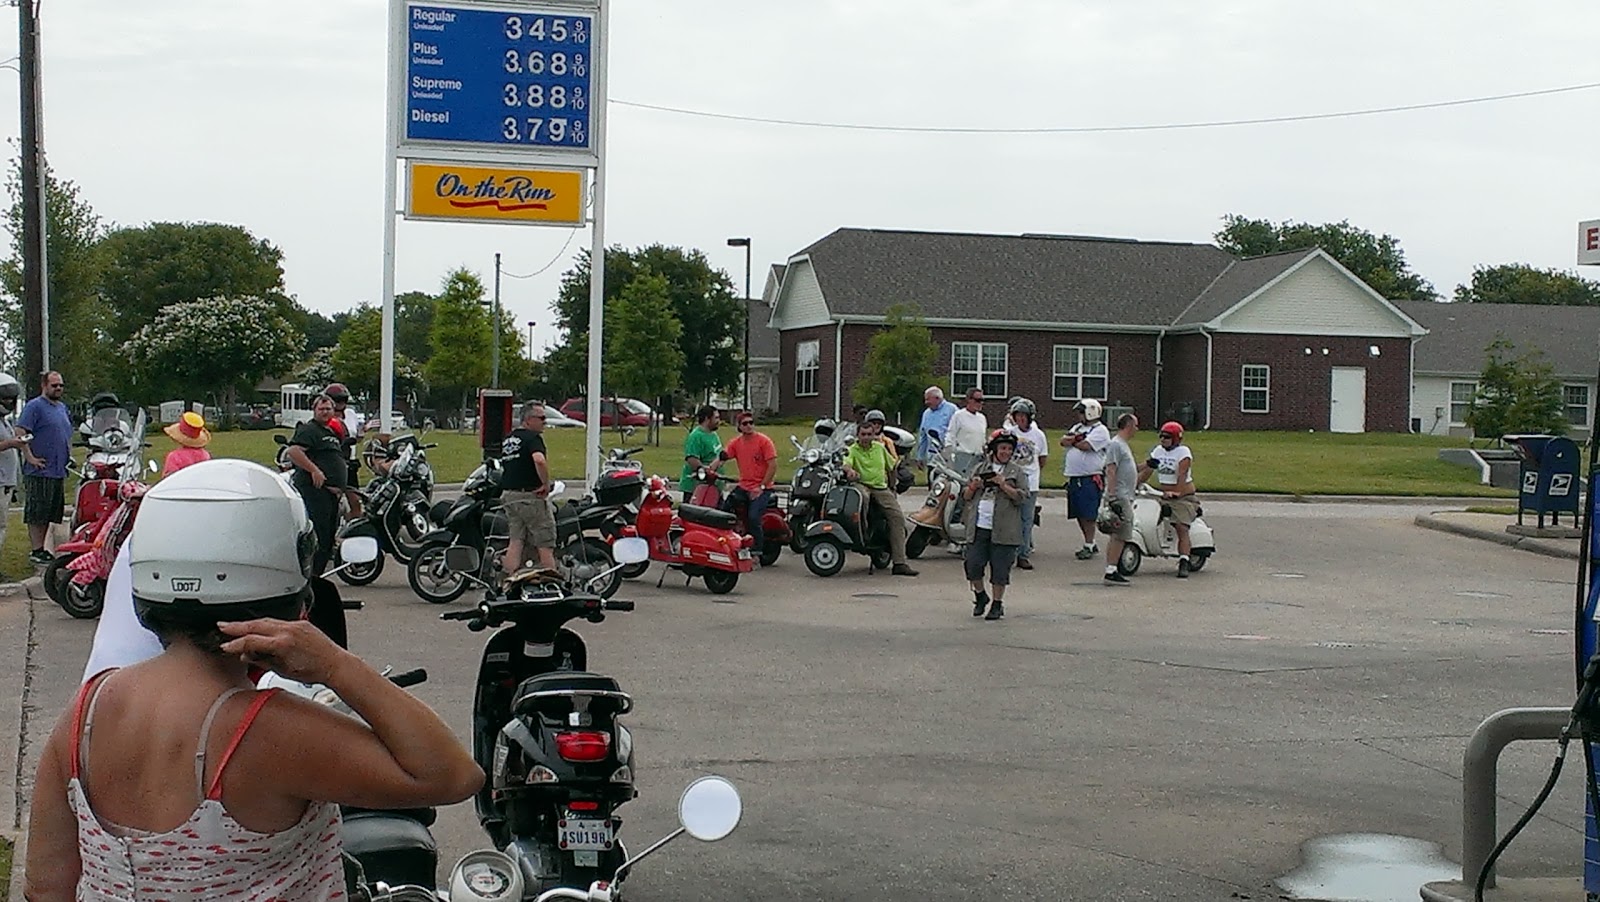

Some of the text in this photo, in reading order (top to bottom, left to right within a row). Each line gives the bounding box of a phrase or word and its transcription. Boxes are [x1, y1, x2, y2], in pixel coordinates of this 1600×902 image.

[413, 8, 456, 23] Regular
[413, 42, 438, 55] Plus
[505, 50, 567, 75] 3.68
[412, 76, 462, 91] Supreme
[504, 83, 567, 109] 3.88
[411, 109, 450, 123] Diesel
[436, 173, 556, 203] On the Run
[177, 582, 196, 592] DOT
